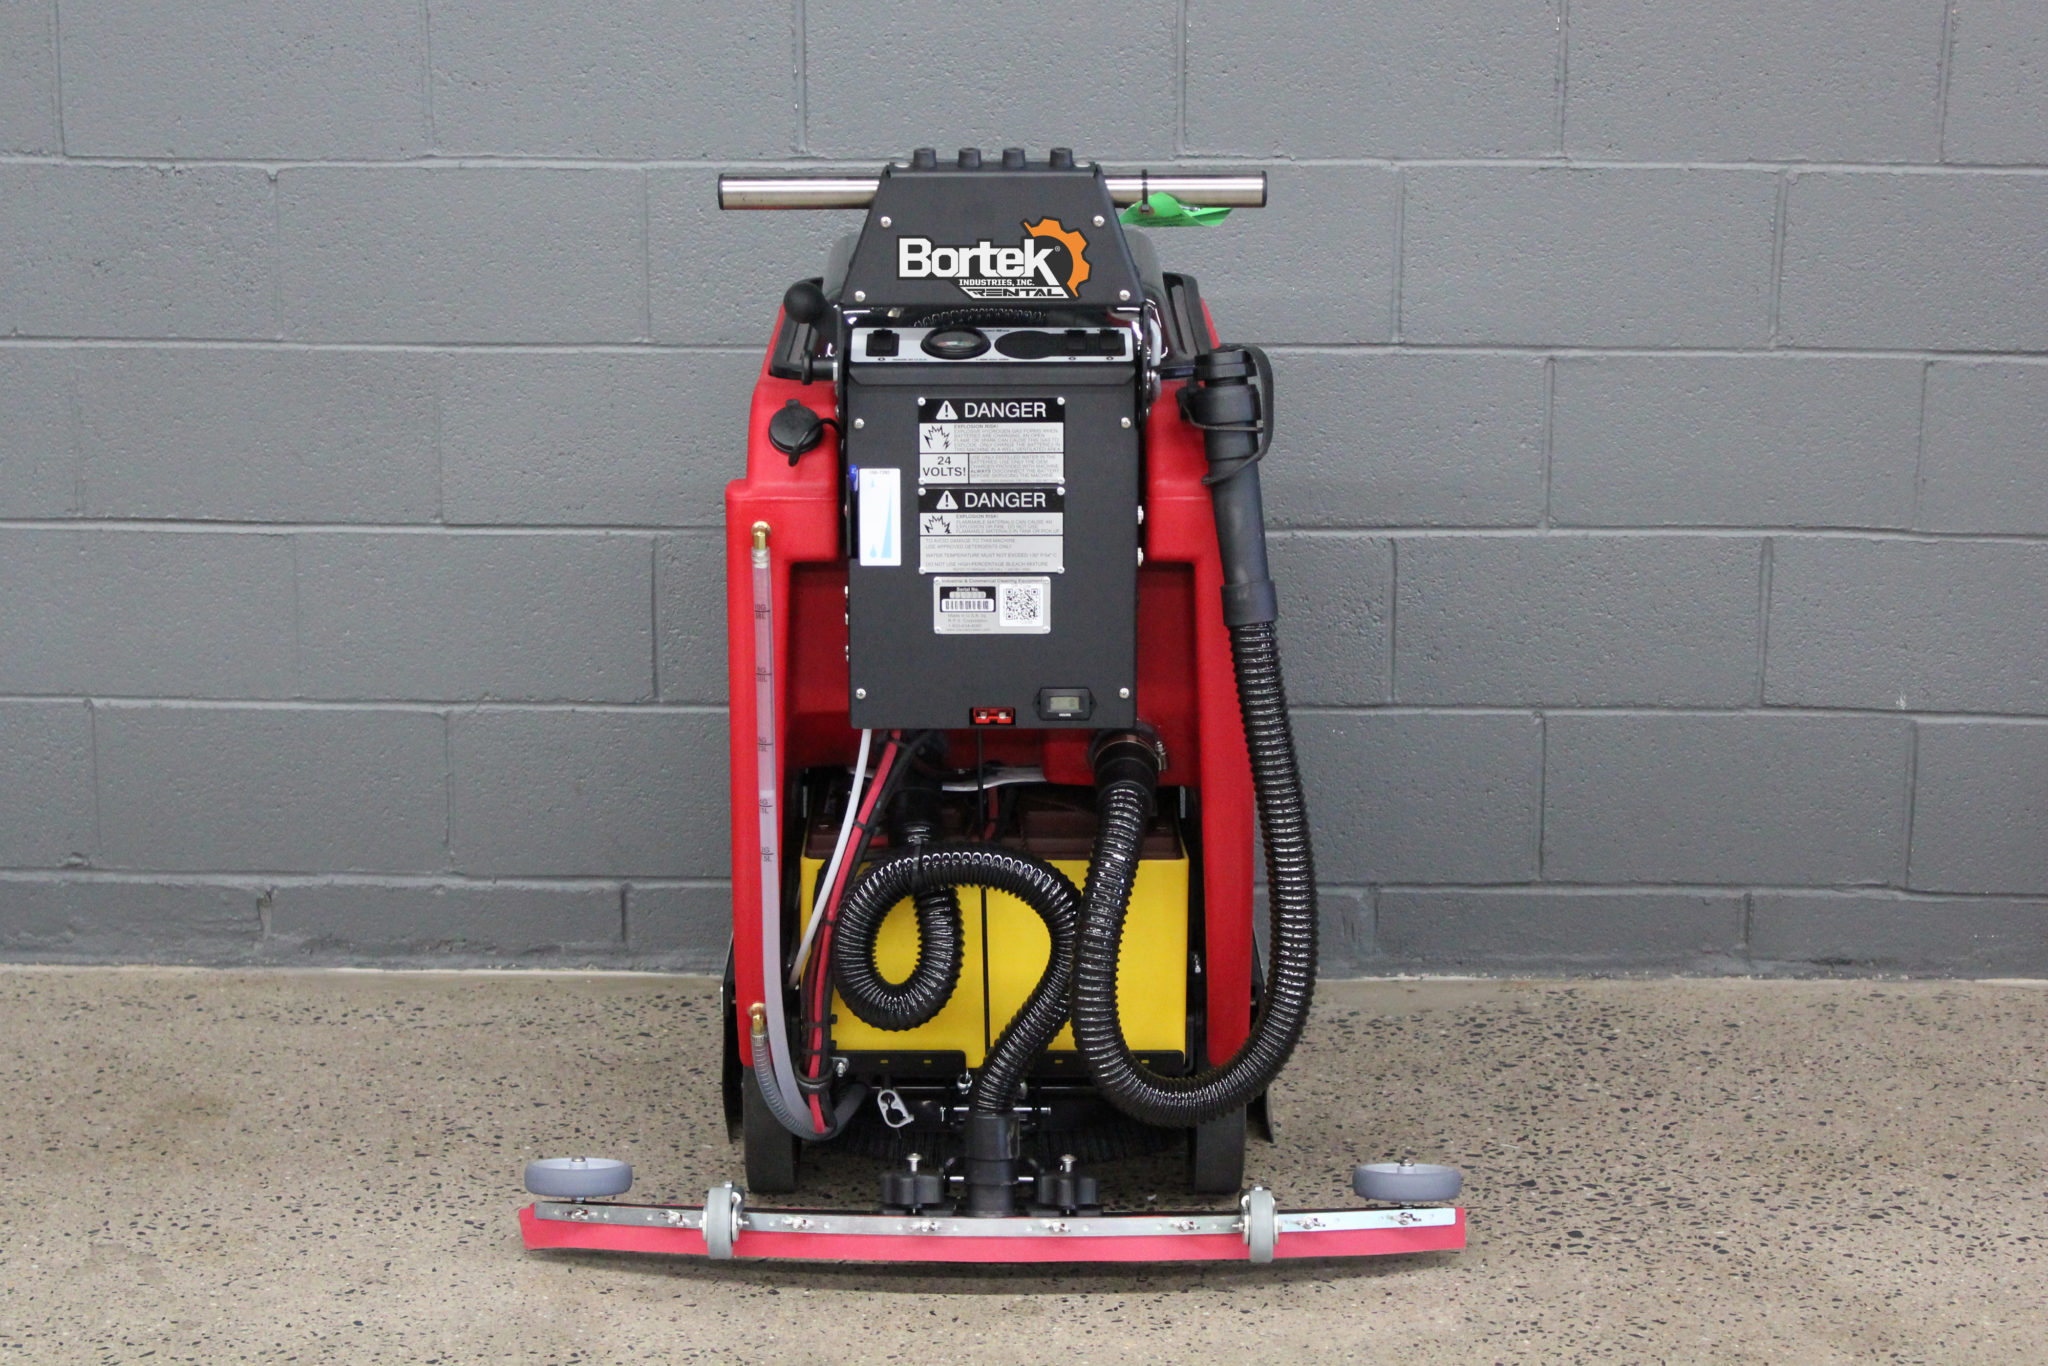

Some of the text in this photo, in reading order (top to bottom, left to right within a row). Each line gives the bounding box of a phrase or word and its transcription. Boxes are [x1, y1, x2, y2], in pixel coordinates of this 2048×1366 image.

[899, 238, 1060, 286] Bortek
[967, 288, 1064, 297] RENTAL
[964, 402, 1046, 418] DANGER
[937, 456, 951, 465] 24
[923, 467, 966, 476] VOLTS!
[964, 492, 1046, 508] DANGER
